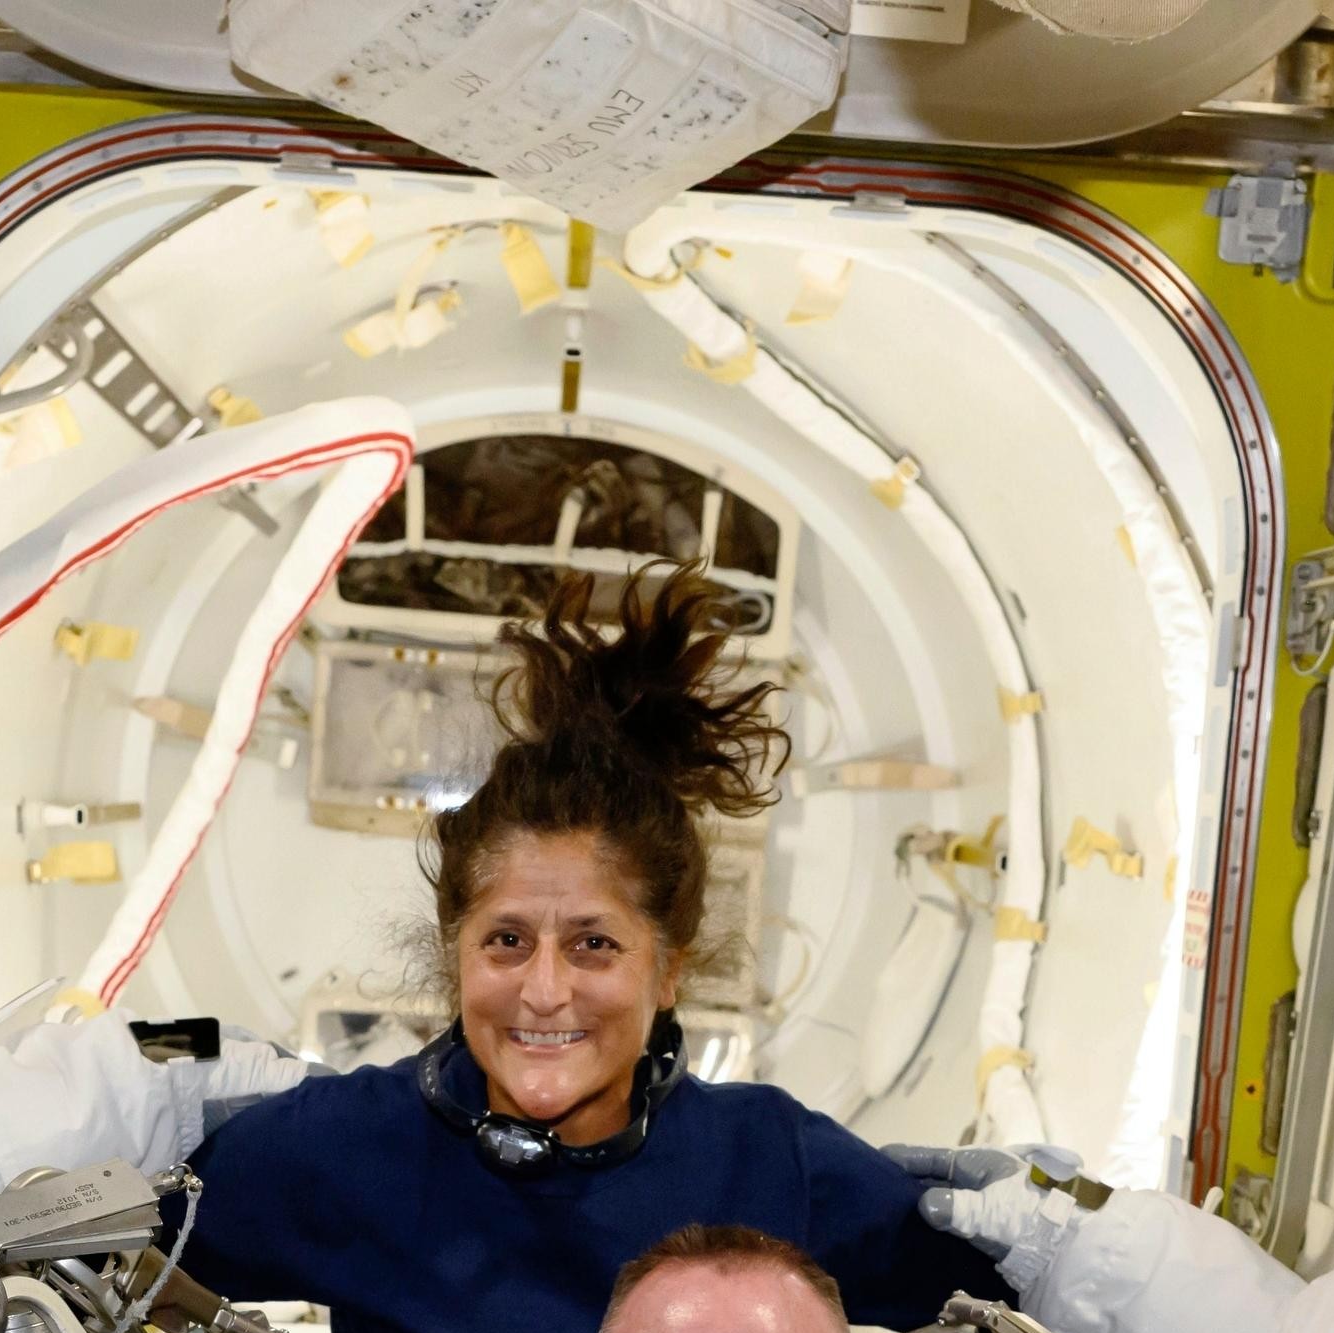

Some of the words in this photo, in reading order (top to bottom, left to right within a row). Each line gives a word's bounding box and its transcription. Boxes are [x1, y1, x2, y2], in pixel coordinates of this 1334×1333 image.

[74, 1183, 94, 1193] ASSY
[82, 1188, 100, 1198] S/N
[82, 1195, 103, 1206] P/N
